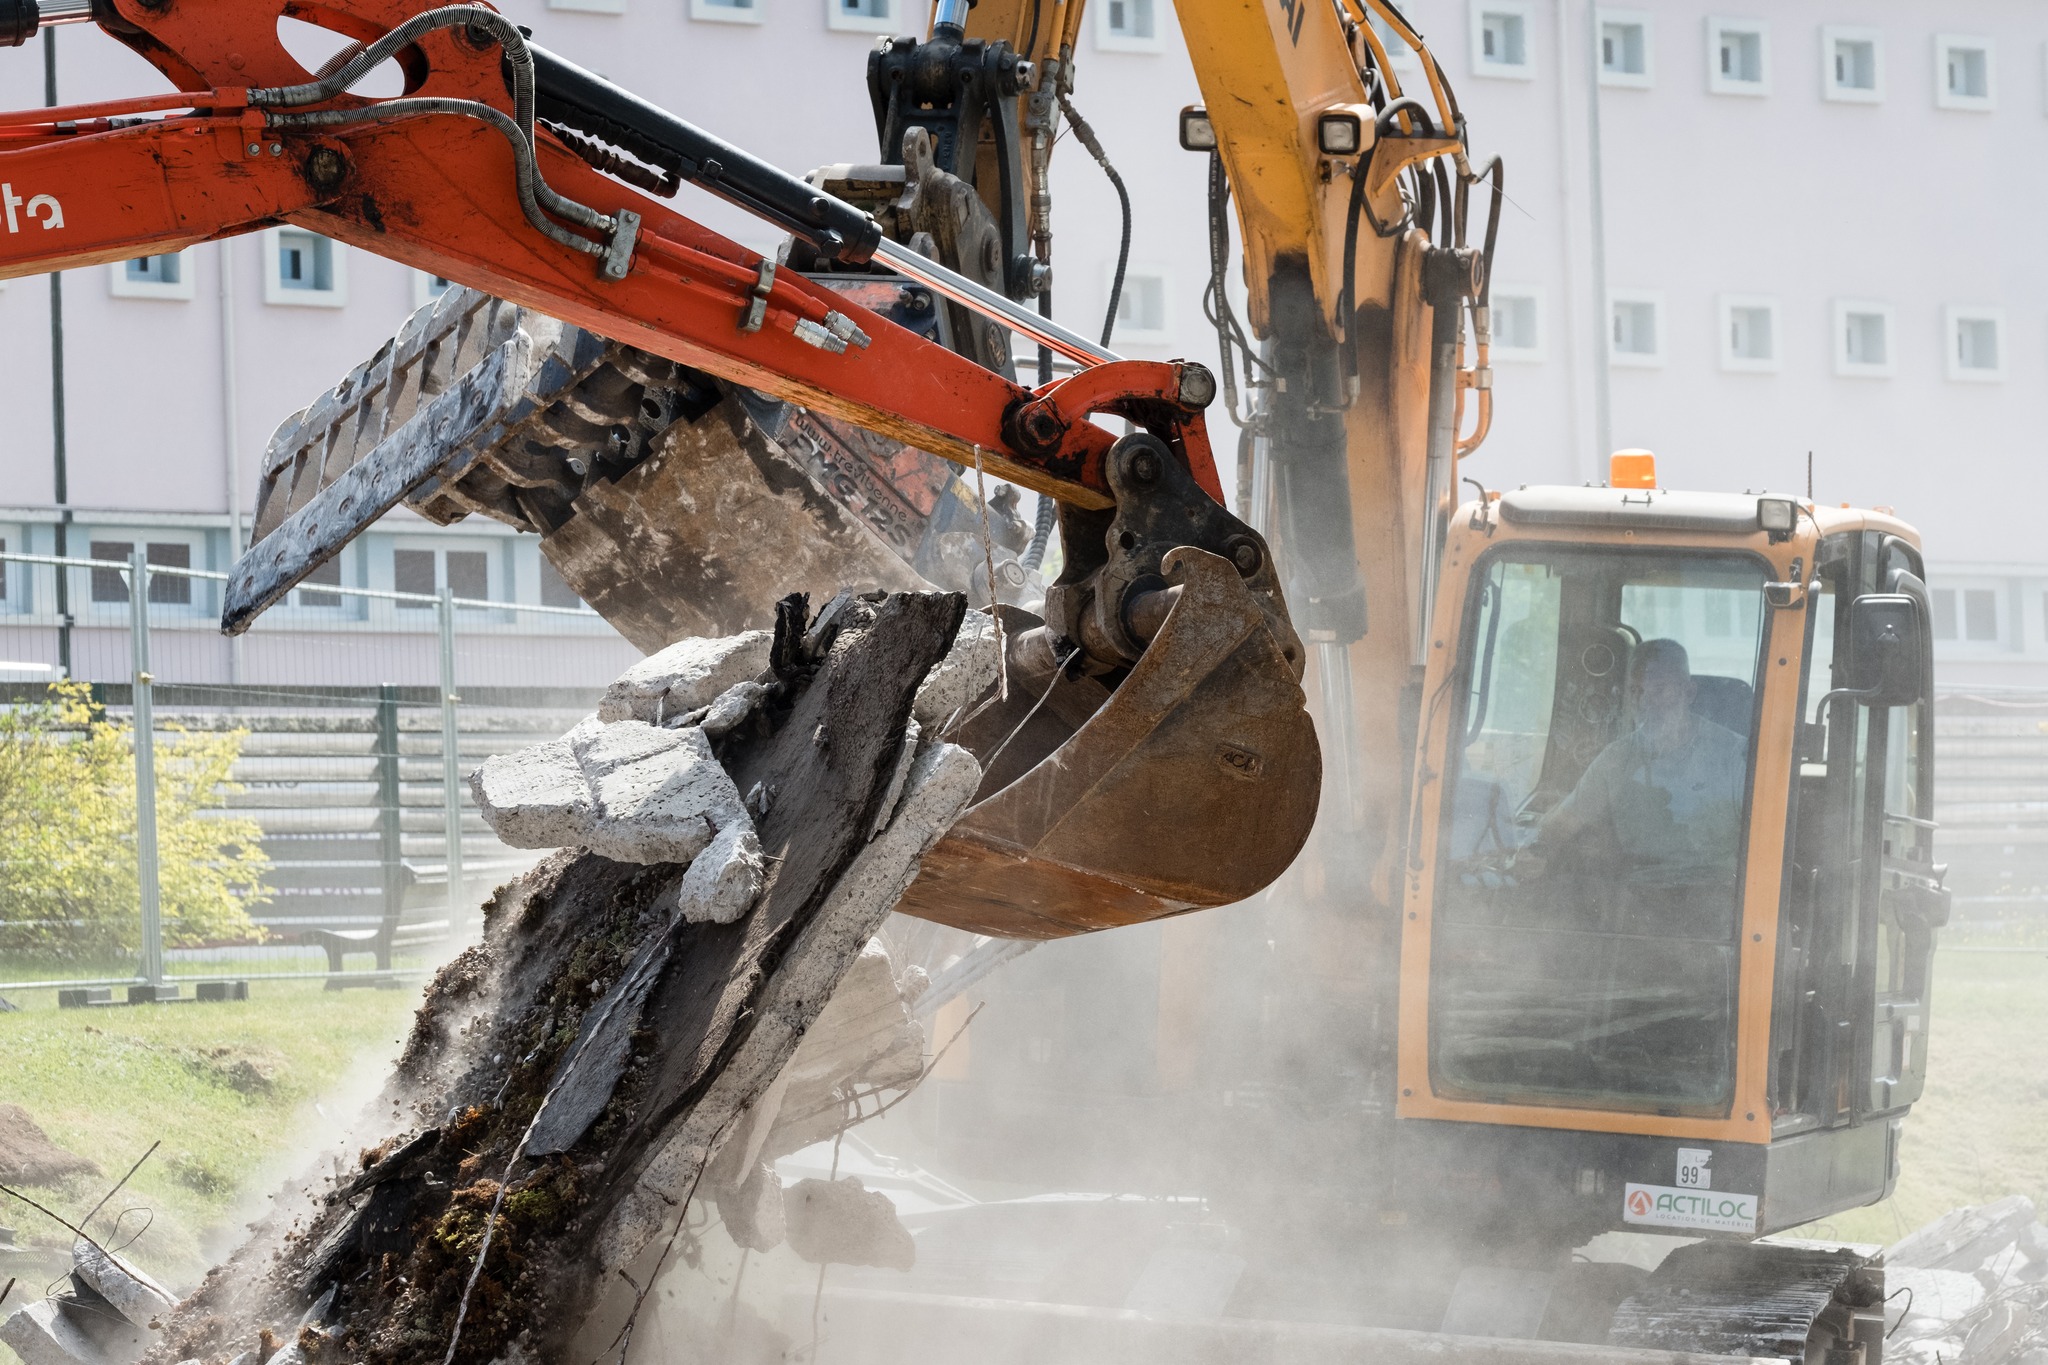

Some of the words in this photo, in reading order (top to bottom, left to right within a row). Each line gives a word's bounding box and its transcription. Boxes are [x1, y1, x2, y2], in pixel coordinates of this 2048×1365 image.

[0, 182, 65, 234] ta
[860, 496, 913, 547] 12S
[1681, 1165, 1699, 1184] 99
[1655, 1212, 1697, 1223] LOCATION
[1656, 1193, 1753, 1220] ACTILOC
